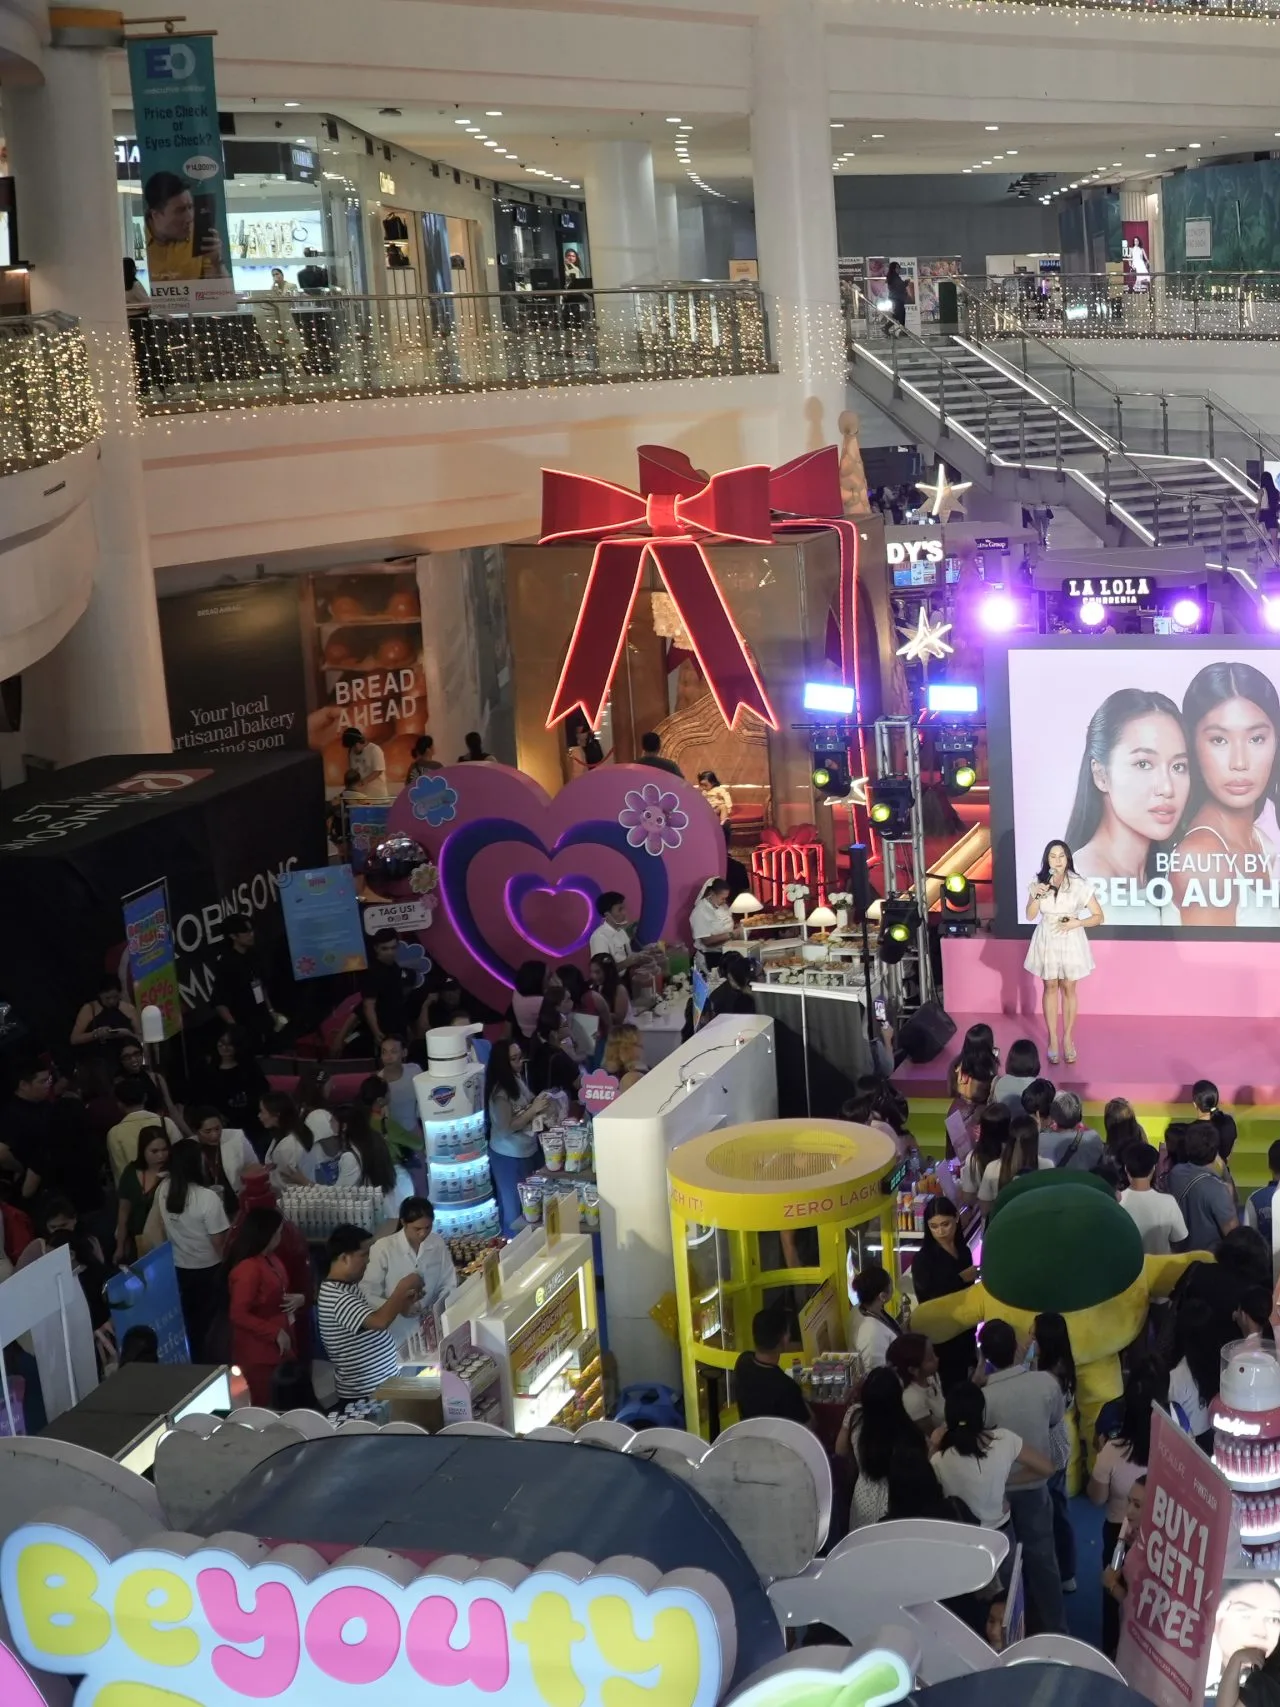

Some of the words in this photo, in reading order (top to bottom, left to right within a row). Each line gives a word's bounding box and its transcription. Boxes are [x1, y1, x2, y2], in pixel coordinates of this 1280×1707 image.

[144, 106, 173, 119] Price
[175, 105, 208, 118] Check
[173, 121, 184, 131] or
[145, 136, 171, 151] Eyes
[174, 133, 212, 147] Check?
[151, 286, 181, 297] LEVEL
[183, 286, 190, 296] 3
[886, 540, 943, 564] DY'S
[1069, 580, 1094, 596] LA
[1100, 578, 1150, 596] LOLA
[335, 668, 415, 704] BREAD
[190, 708, 229, 728] Your
[230, 694, 269, 719] local
[336, 696, 417, 732] AHEAD
[172, 720, 240, 751] rtisanal
[240, 712, 295, 736] bakery
[247, 733, 286, 753] soon
[1155, 852, 1233, 875] BEAUTY
[1244, 853, 1272, 875] BY
[1091, 878, 1174, 908] BELO
[379, 907, 397, 917] TAG
[399, 905, 416, 915] US!
[585, 1089, 616, 1101] SALE!
[688, 1196, 704, 1212] IT!
[783, 1198, 834, 1218] ZERO
[1151, 1485, 1198, 1552] BUY
[1197, 1523, 1210, 1568] 1
[1146, 1530, 1193, 1597] GET
[1193, 1566, 1205, 1611] 1
[1136, 1577, 1201, 1649] FREE
[17, 1543, 700, 1707] Beyouty
